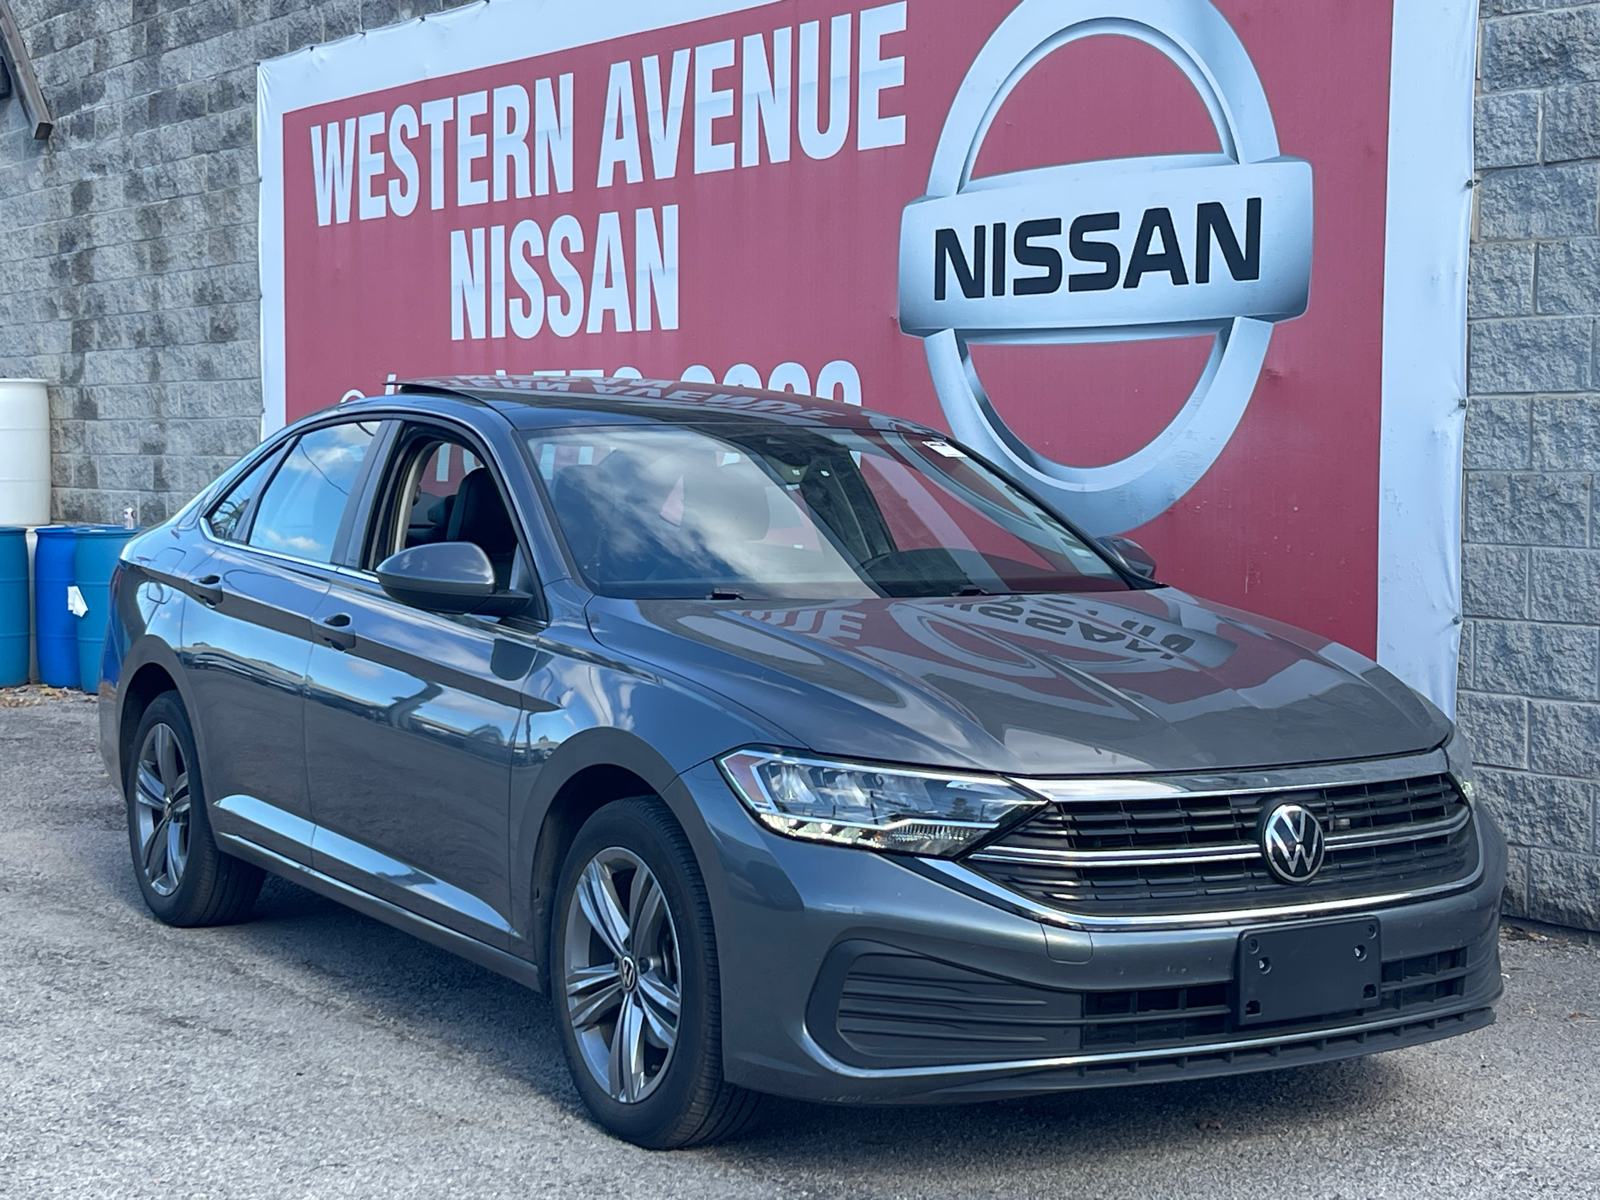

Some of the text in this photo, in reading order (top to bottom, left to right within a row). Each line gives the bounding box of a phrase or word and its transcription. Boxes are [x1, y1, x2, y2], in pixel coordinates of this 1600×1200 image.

[310, 1, 907, 227] WESTERN AVENUE
[450, 204, 679, 341] NISSAN
[935, 197, 1262, 300] NISSAN
[1266, 805, 1323, 878] VW
